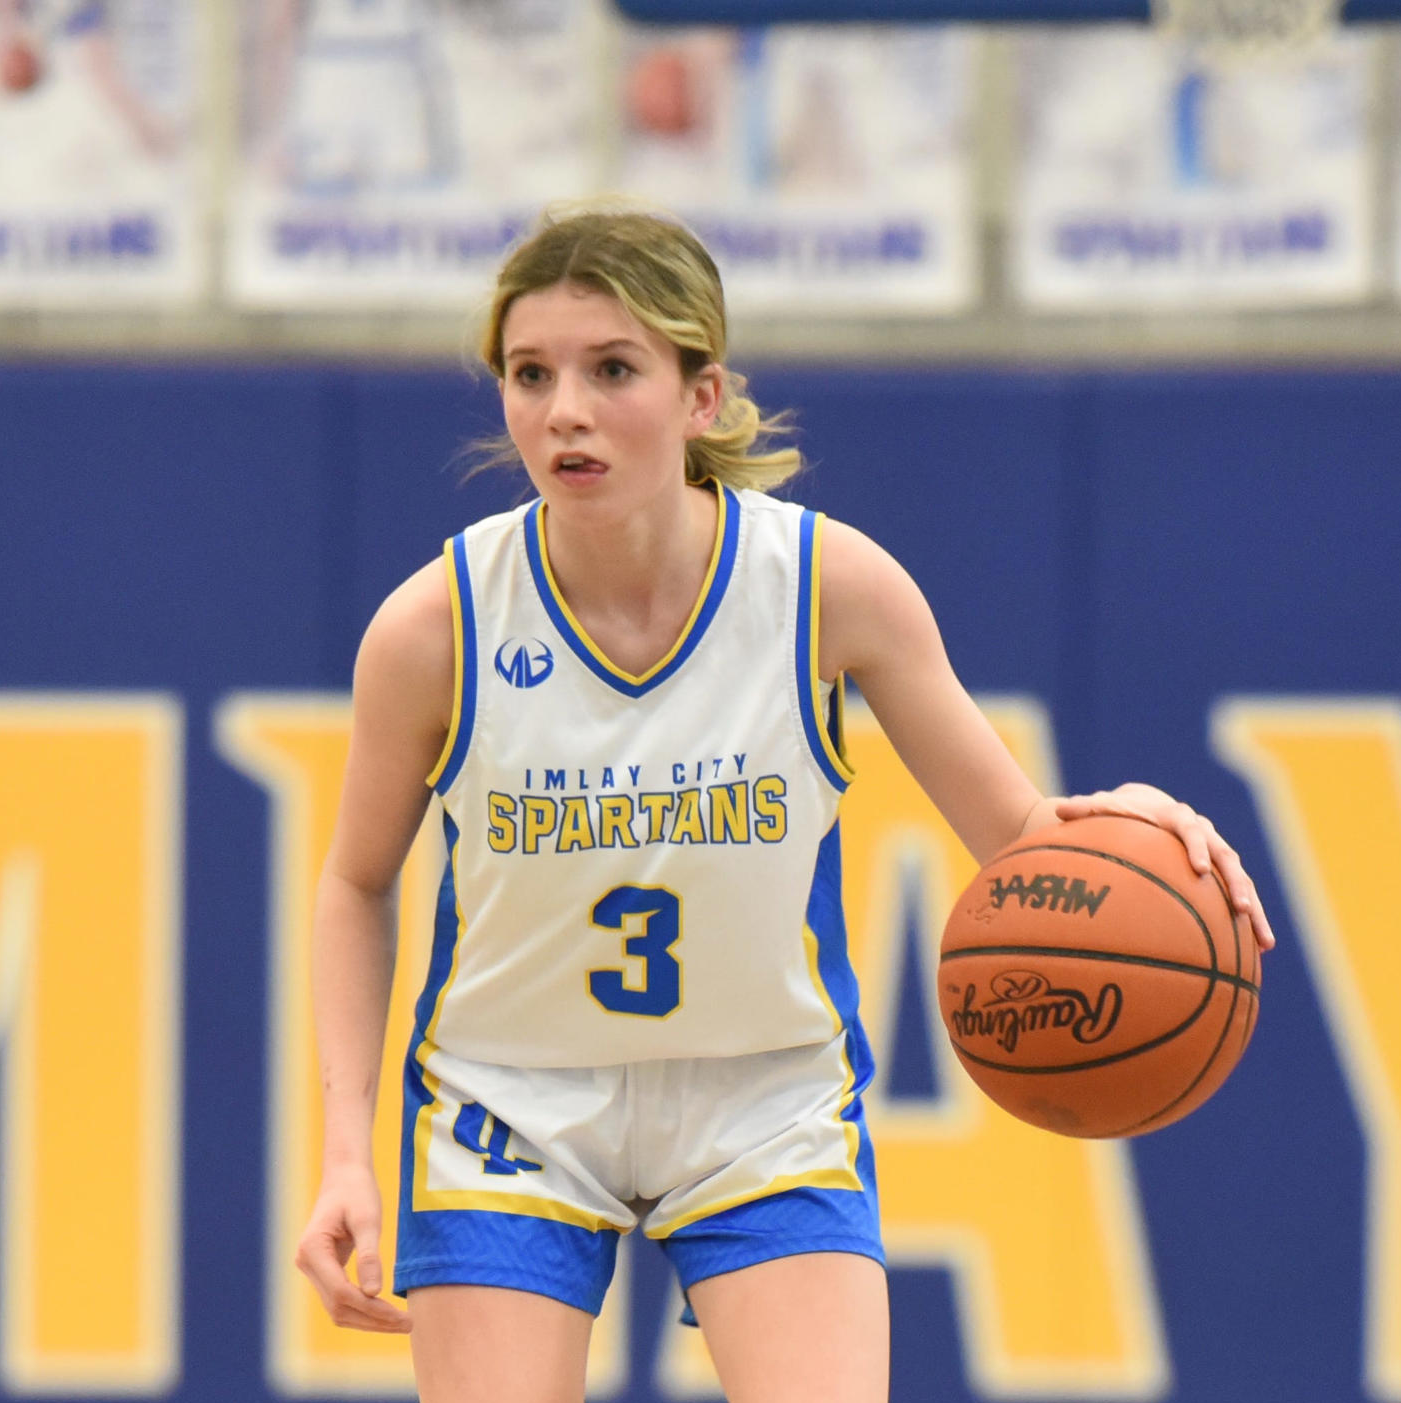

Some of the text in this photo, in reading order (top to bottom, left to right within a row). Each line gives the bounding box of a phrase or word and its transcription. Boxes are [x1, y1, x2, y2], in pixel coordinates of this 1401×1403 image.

[525, 752, 748, 790] IMLAY CITY
[486, 773, 788, 855] SPARTANS
[584, 881, 684, 1021] 3
[951, 982, 1124, 1054] Rawlings
